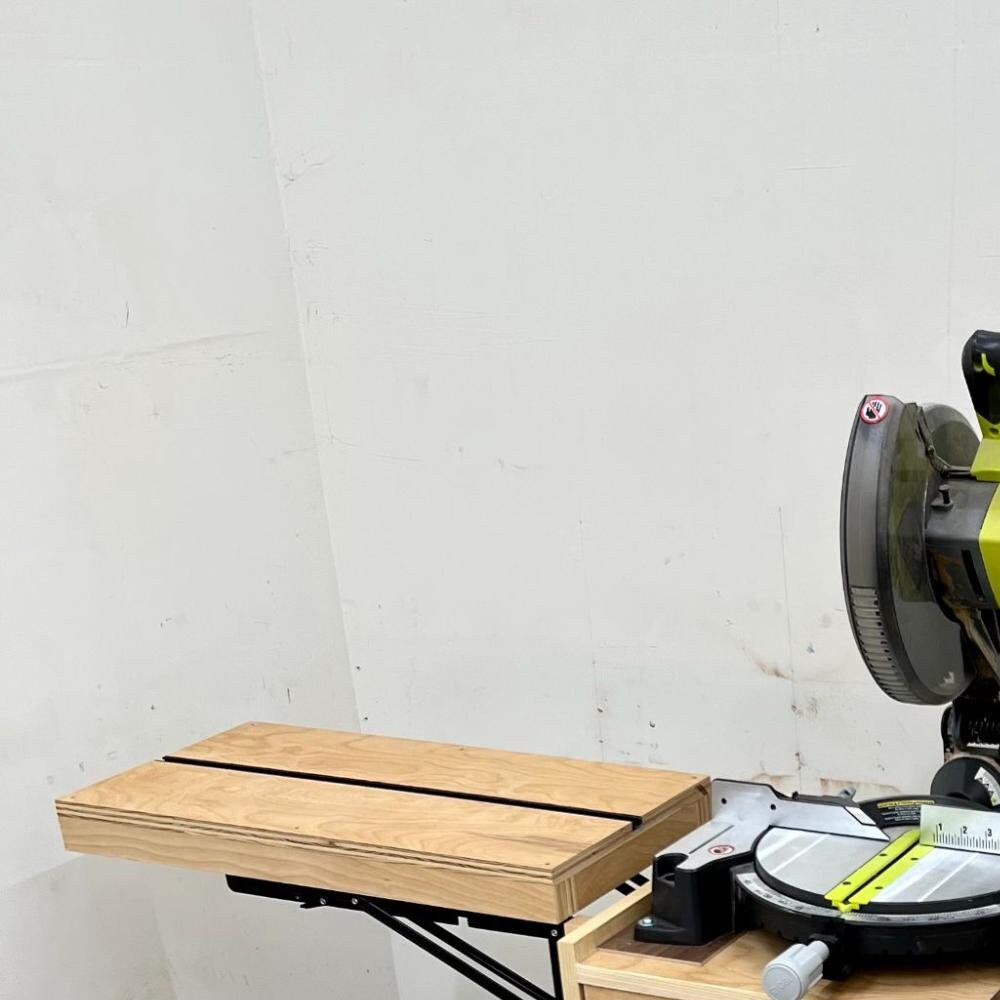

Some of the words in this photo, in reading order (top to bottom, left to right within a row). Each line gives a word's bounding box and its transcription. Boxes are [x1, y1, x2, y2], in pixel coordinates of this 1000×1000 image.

[938, 823, 943, 831] 1
[962, 826, 968, 834] 2
[987, 828, 993, 837] 3
